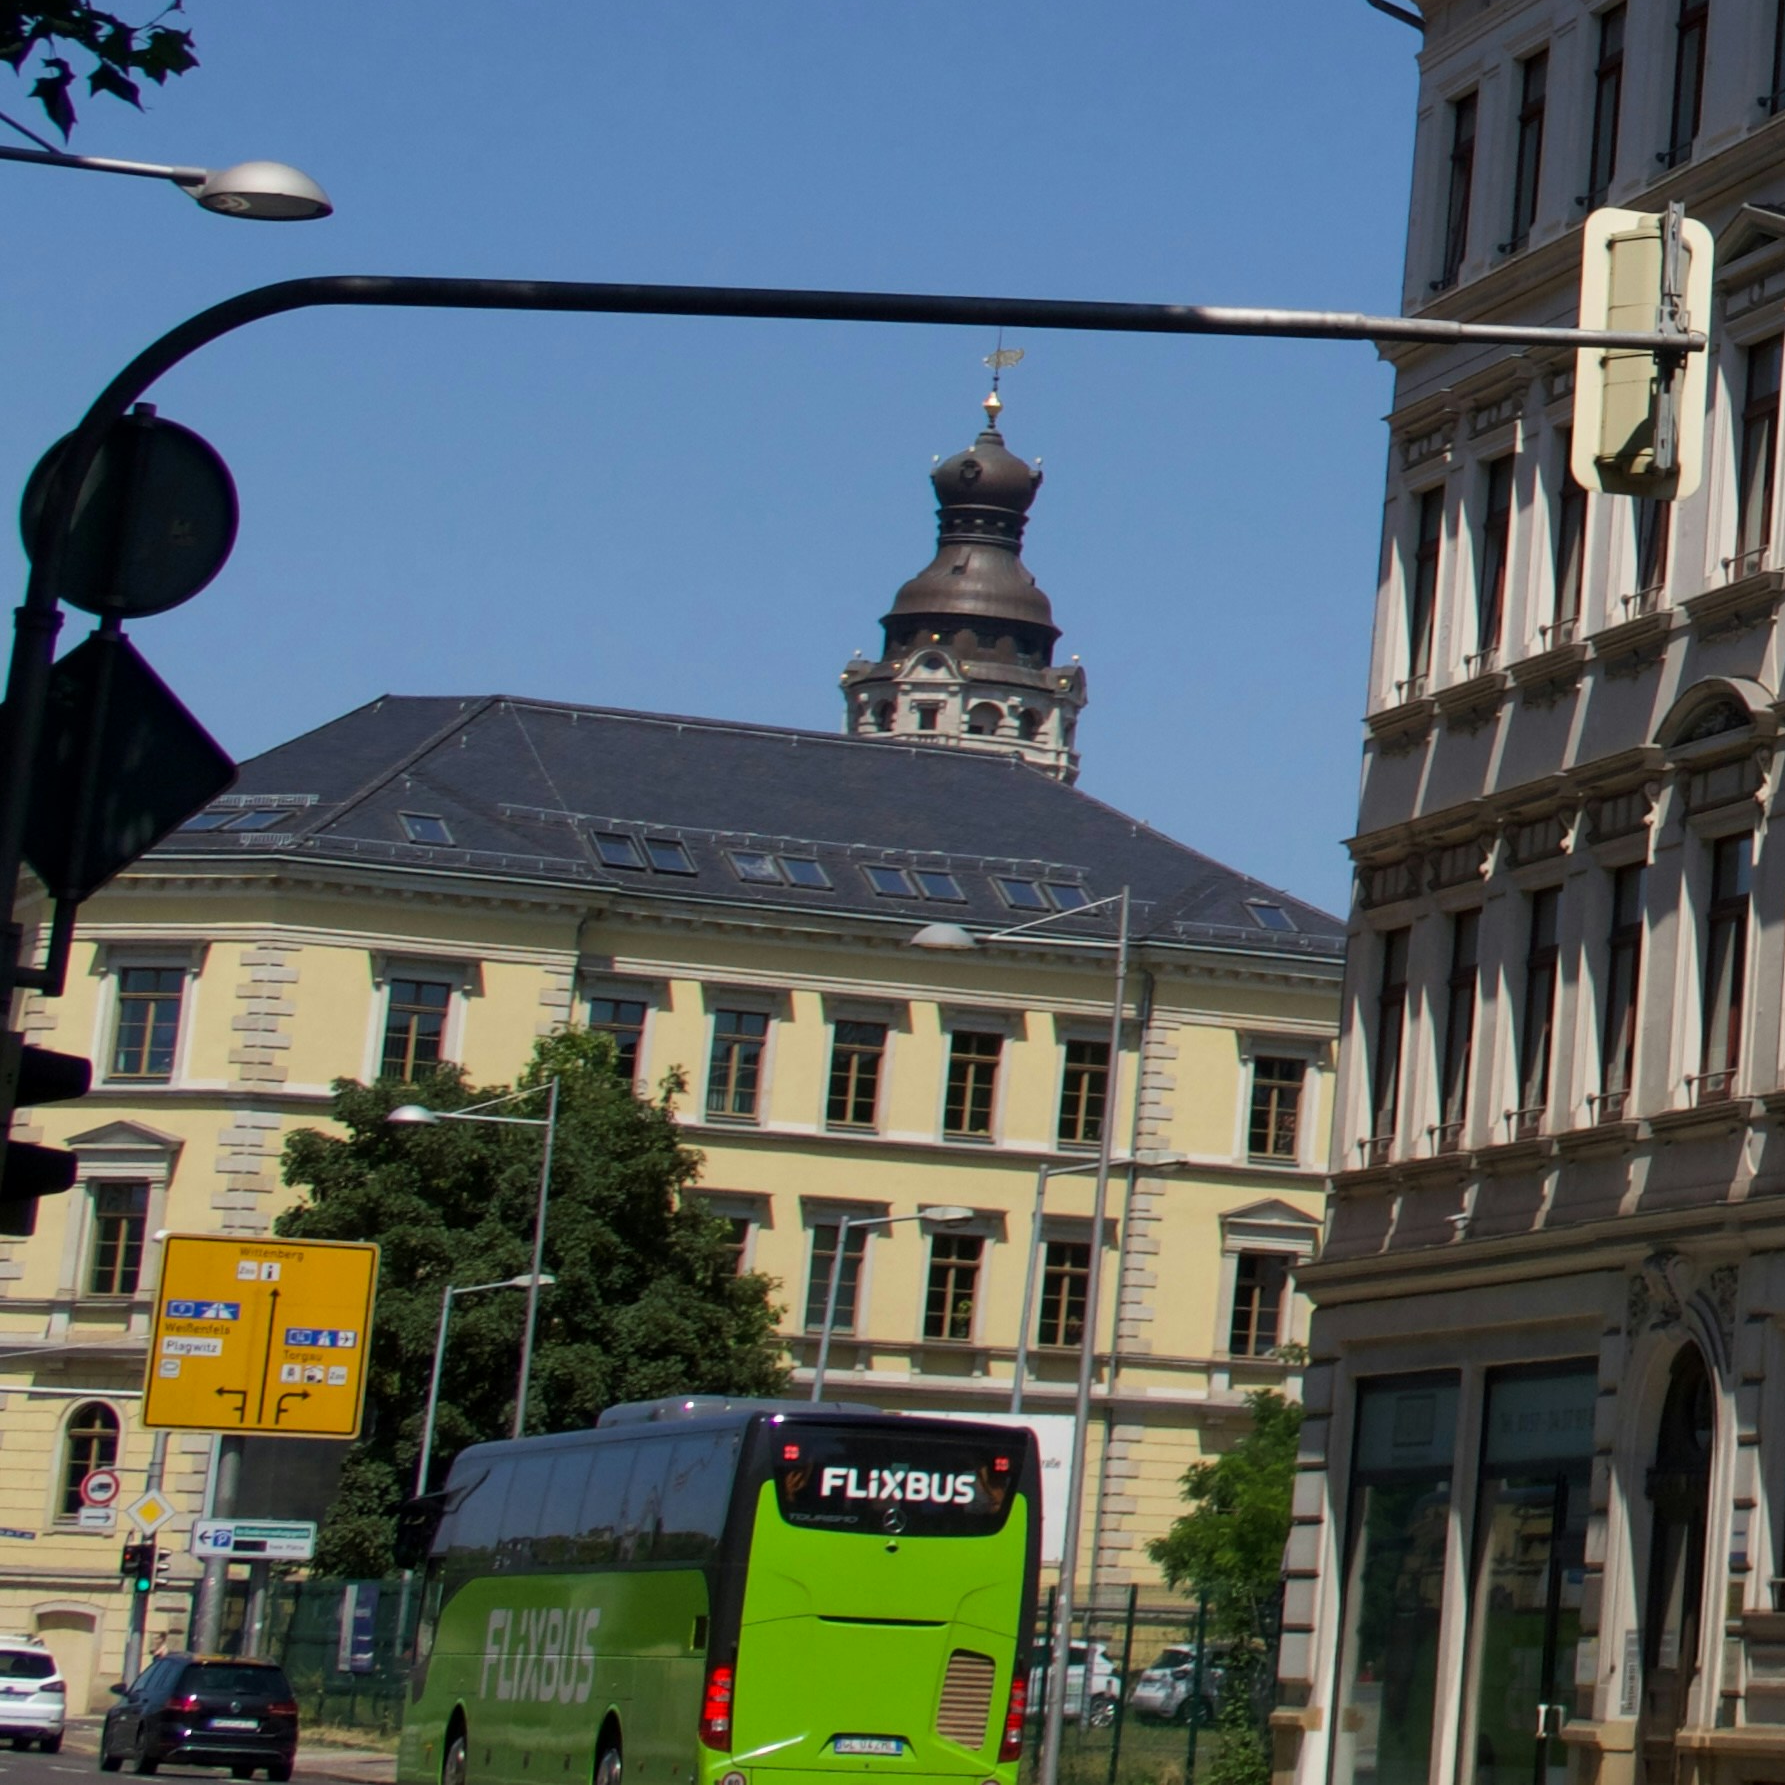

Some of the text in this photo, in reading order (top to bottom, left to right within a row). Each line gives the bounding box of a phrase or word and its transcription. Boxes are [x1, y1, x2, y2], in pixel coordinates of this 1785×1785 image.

[164, 1321, 231, 1336] Weißenfels
[166, 1339, 218, 1354] Plagwitz
[283, 1349, 323, 1363] Torgau
